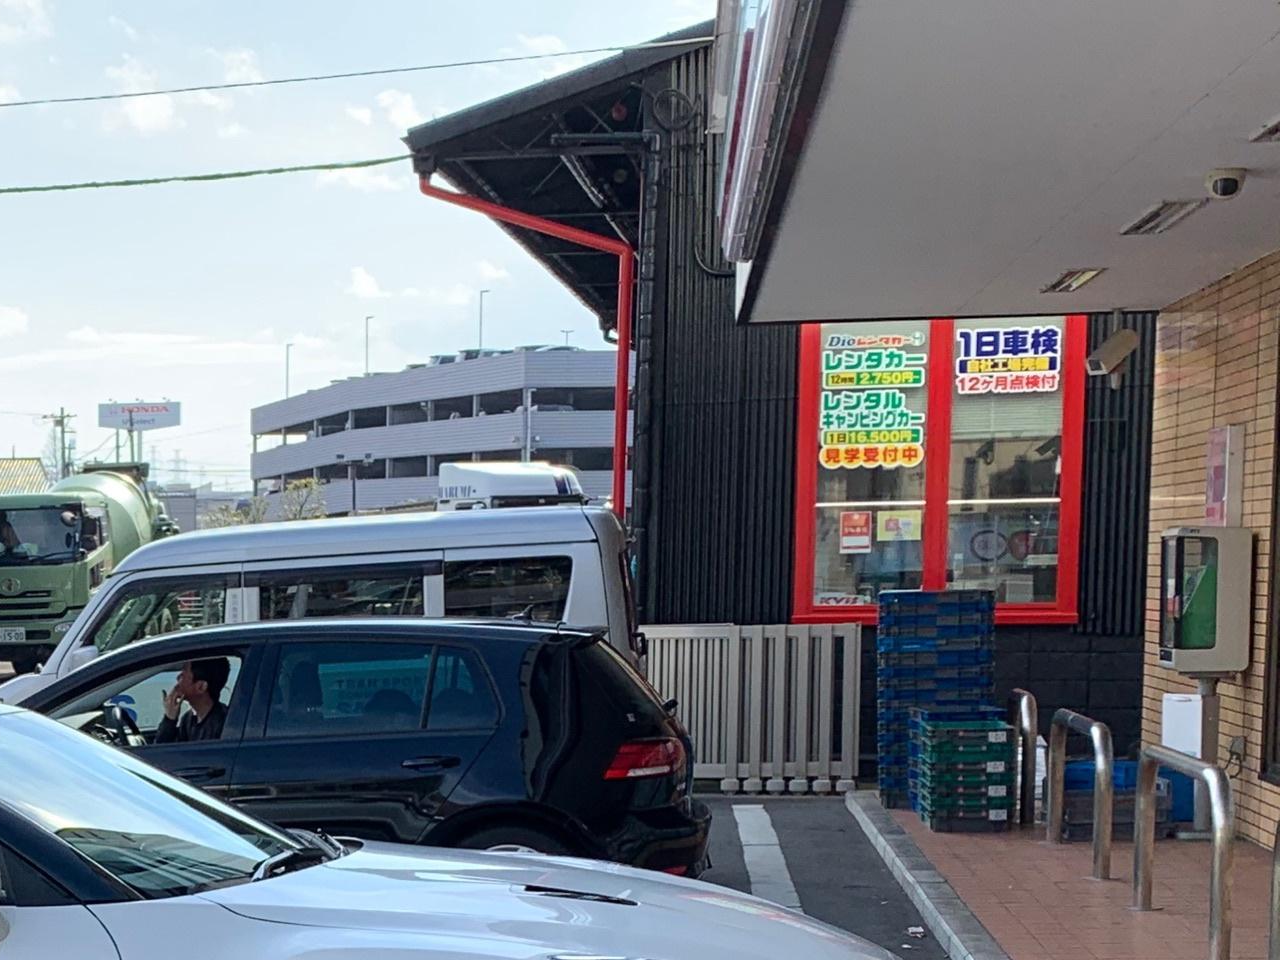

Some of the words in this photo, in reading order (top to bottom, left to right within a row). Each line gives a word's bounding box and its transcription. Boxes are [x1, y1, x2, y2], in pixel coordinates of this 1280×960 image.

[960, 329, 1058, 357] 1日車検
[825, 351, 924, 370] レンタカー
[121, 406, 169, 414] HONDA
[824, 391, 903, 411] レンタル
[822, 410, 923, 429] キャンピングカー
[824, 446, 919, 464] 見学受付中
